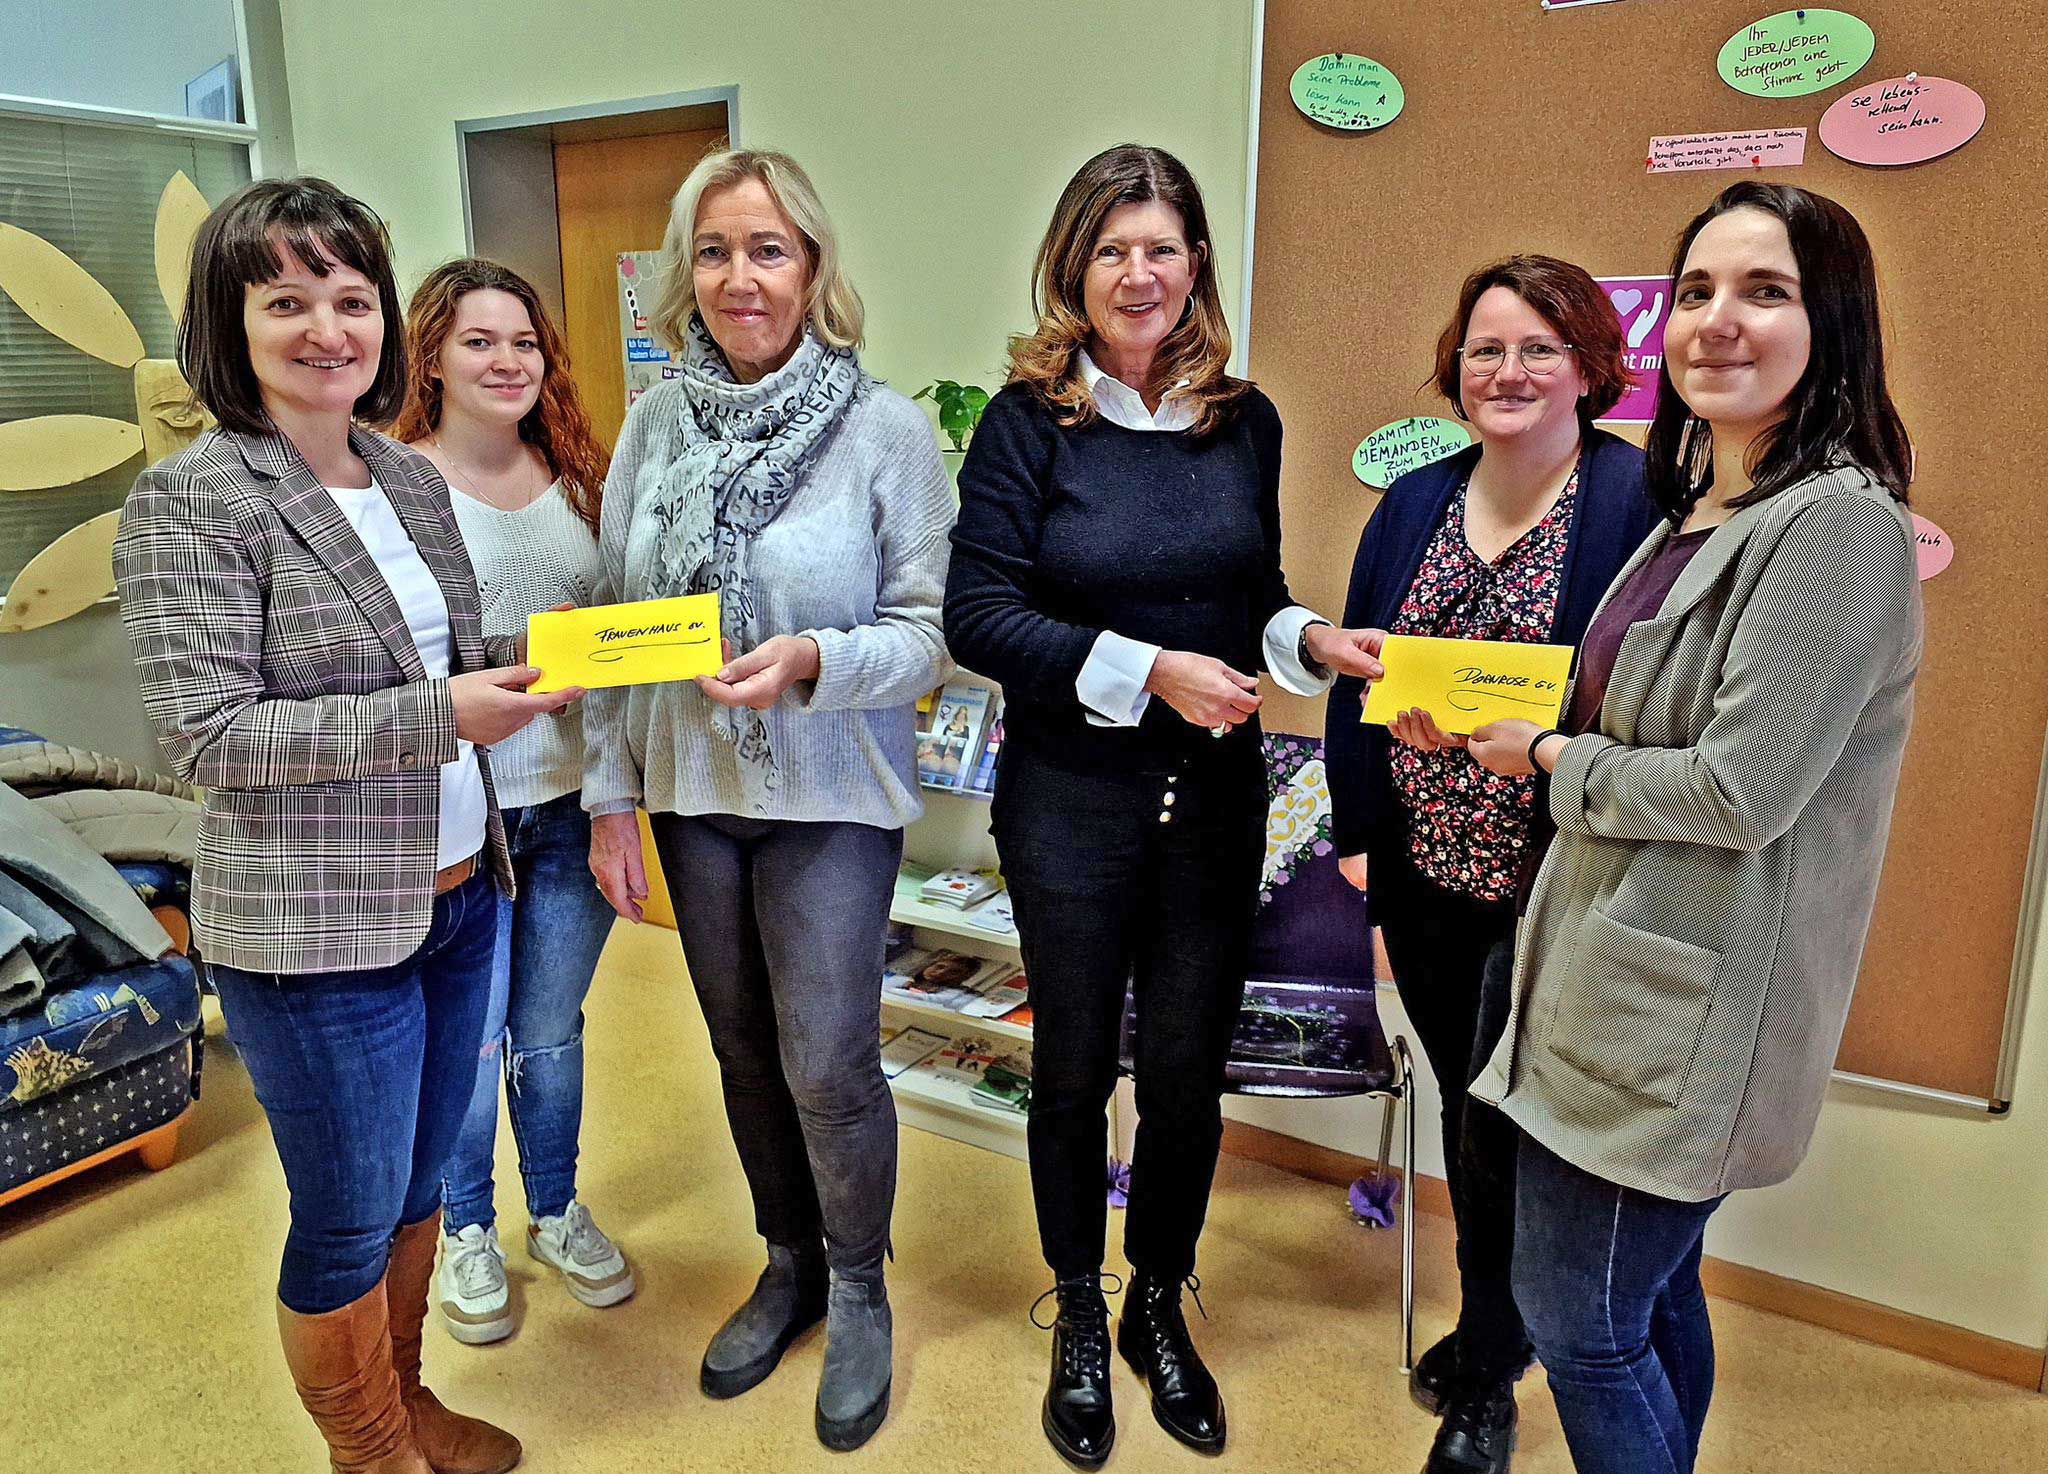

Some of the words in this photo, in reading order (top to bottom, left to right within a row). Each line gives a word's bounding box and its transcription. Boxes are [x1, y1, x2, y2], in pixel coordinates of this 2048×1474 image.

[1748, 25, 1768, 41] Ihr
[1358, 63, 1378, 72] man
[1734, 58, 1796, 79] Betroffenen
[1804, 49, 1830, 62] eine
[1762, 72, 1805, 91] Stimme
[1815, 60, 1848, 82] gebt
[1367, 423, 1412, 447] DAMIT
[1419, 418, 1440, 431] ICH
[1359, 435, 1440, 466] JEMANDEN
[1384, 457, 1413, 470] ZUM
[594, 623, 682, 643] FRAUENHAUS
